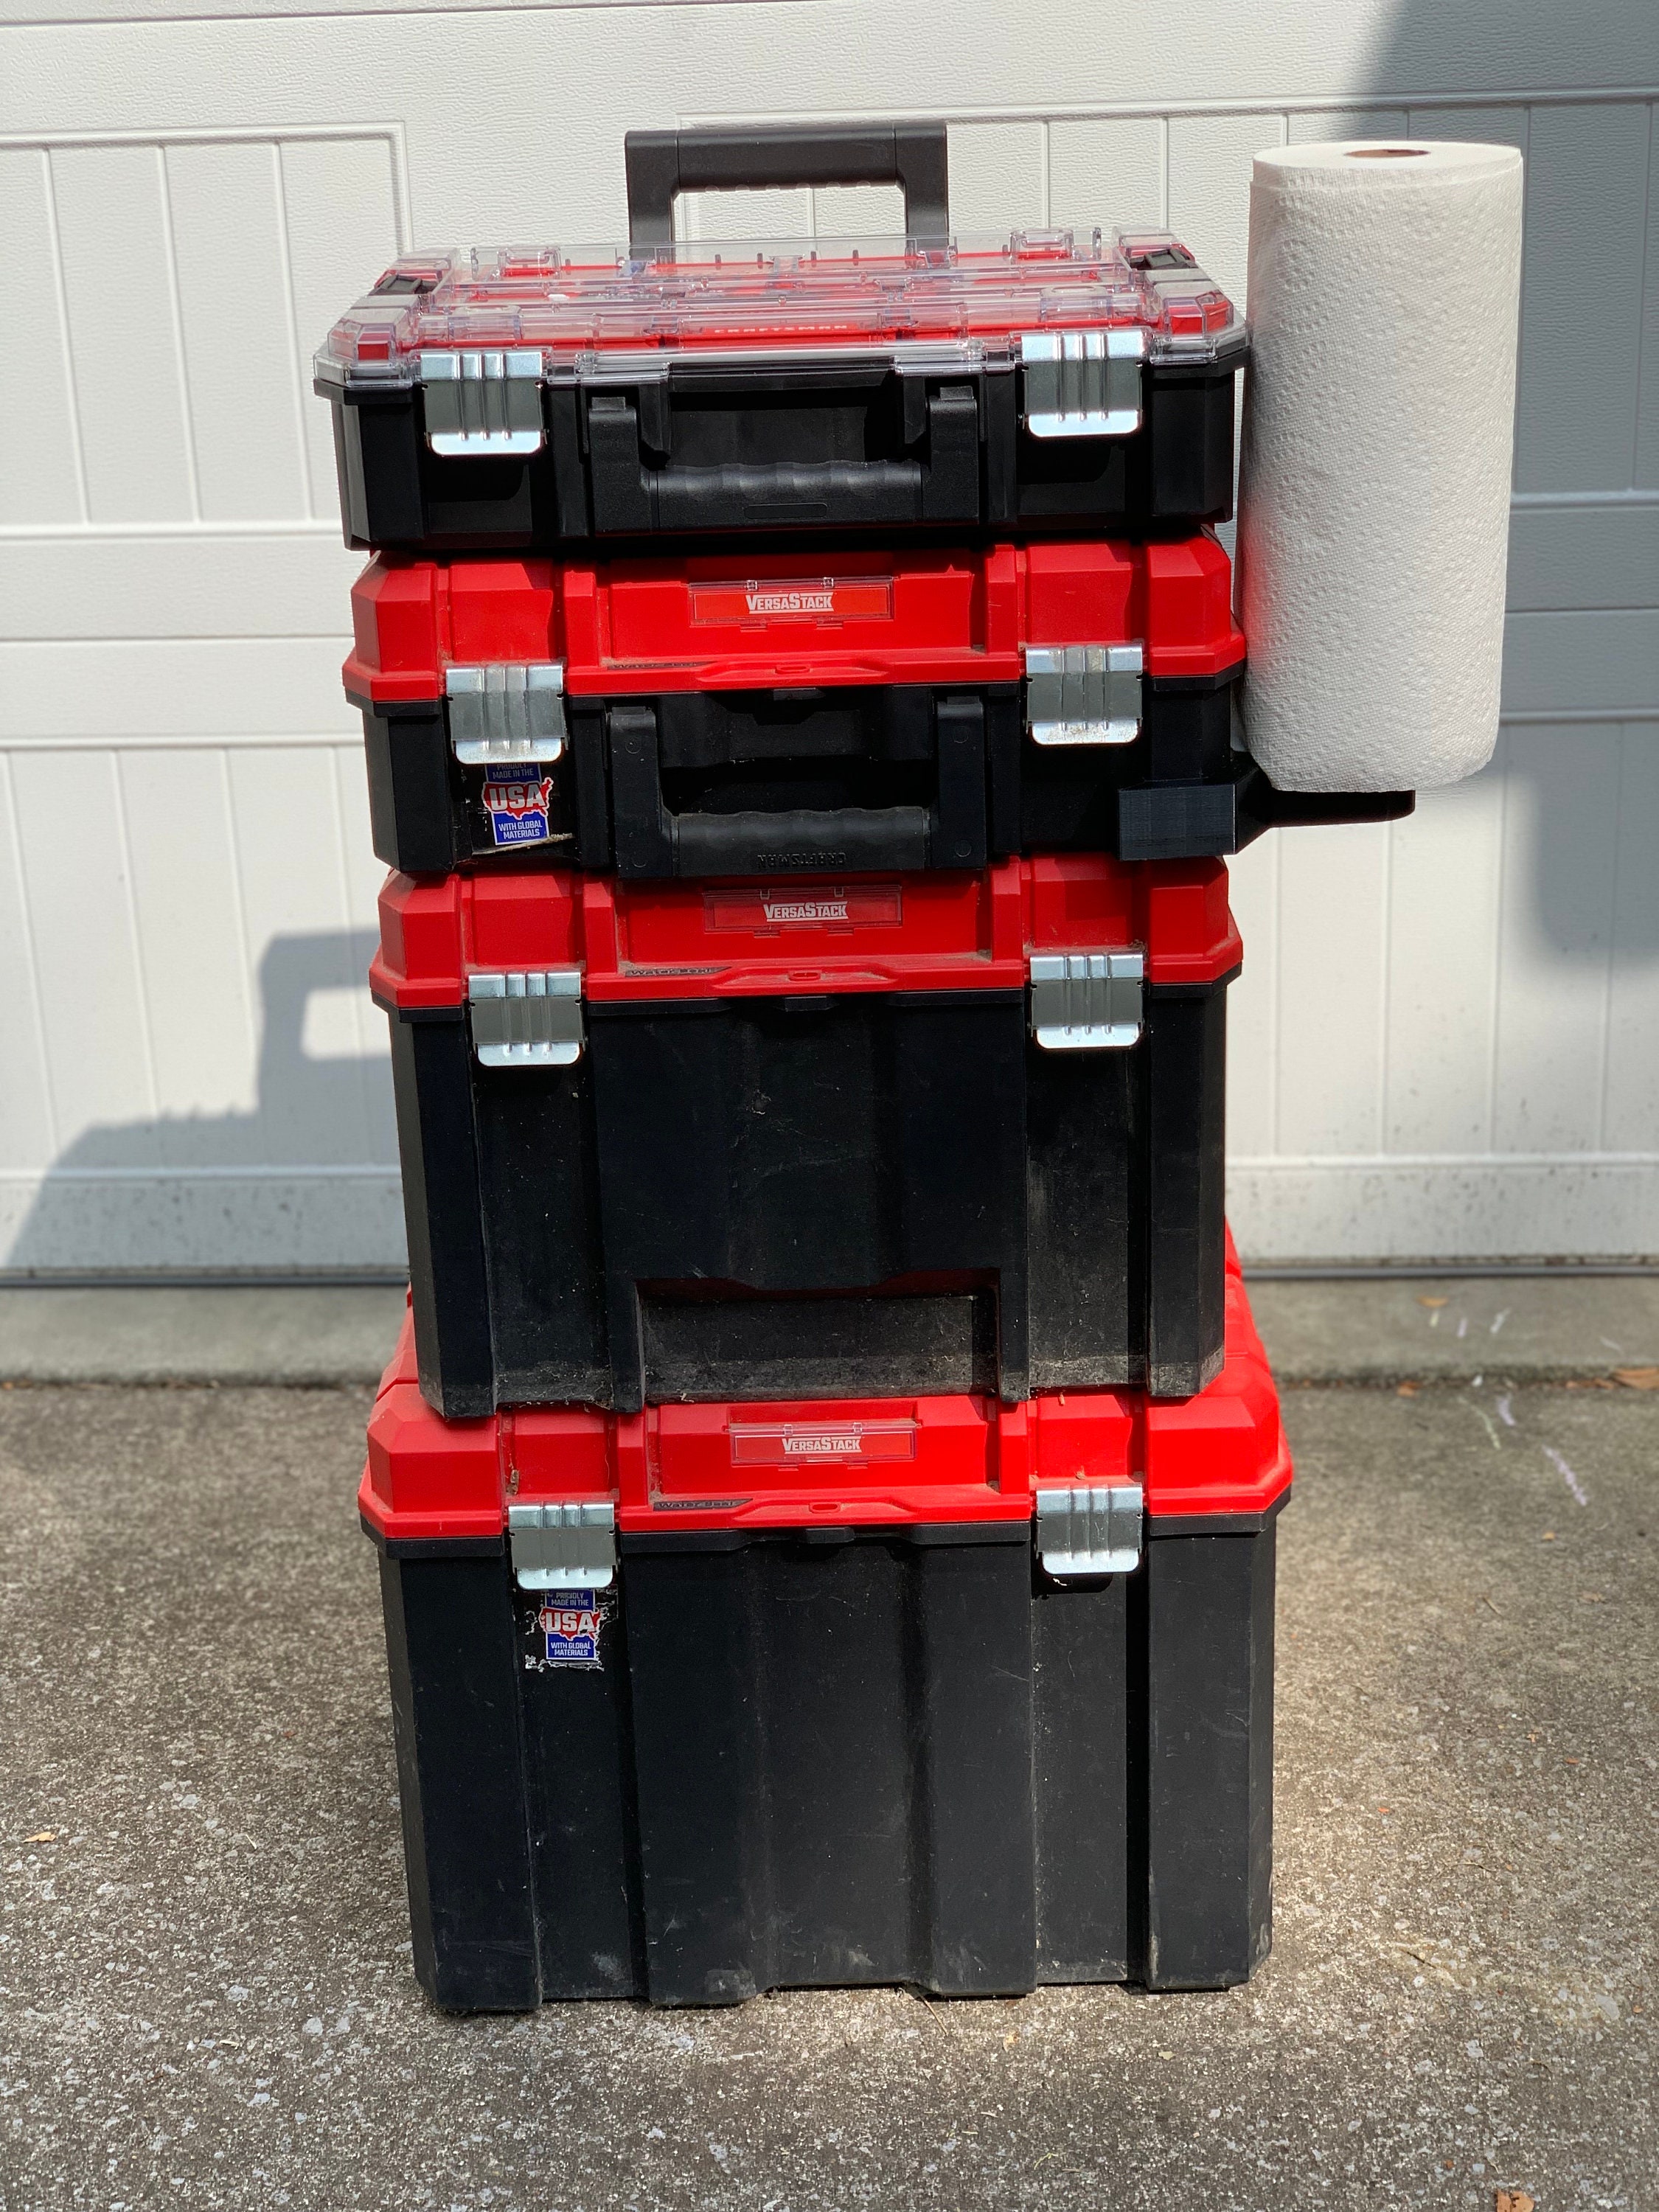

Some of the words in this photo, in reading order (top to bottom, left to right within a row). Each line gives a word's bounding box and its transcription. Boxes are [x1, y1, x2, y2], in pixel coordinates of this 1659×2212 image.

[745, 592, 834, 613] VERSASTACK
[493, 771, 512, 779] MADE
[513, 770, 521, 778] IN
[521, 768, 535, 776] THE
[489, 784, 546, 810] USA
[498, 823, 517, 832] WITH
[518, 820, 543, 830] GLOBAL
[504, 829, 540, 839] MATERIALS
[763, 902, 849, 920] VERSASTACK
[782, 1436, 862, 1453] VERSASTACK
[551, 1599, 569, 1607] MADE
[569, 1599, 577, 1607] IN
[577, 1599, 589, 1607] THE
[546, 1612, 597, 1634] USA
[568, 1641, 591, 1649] GLOBAL
